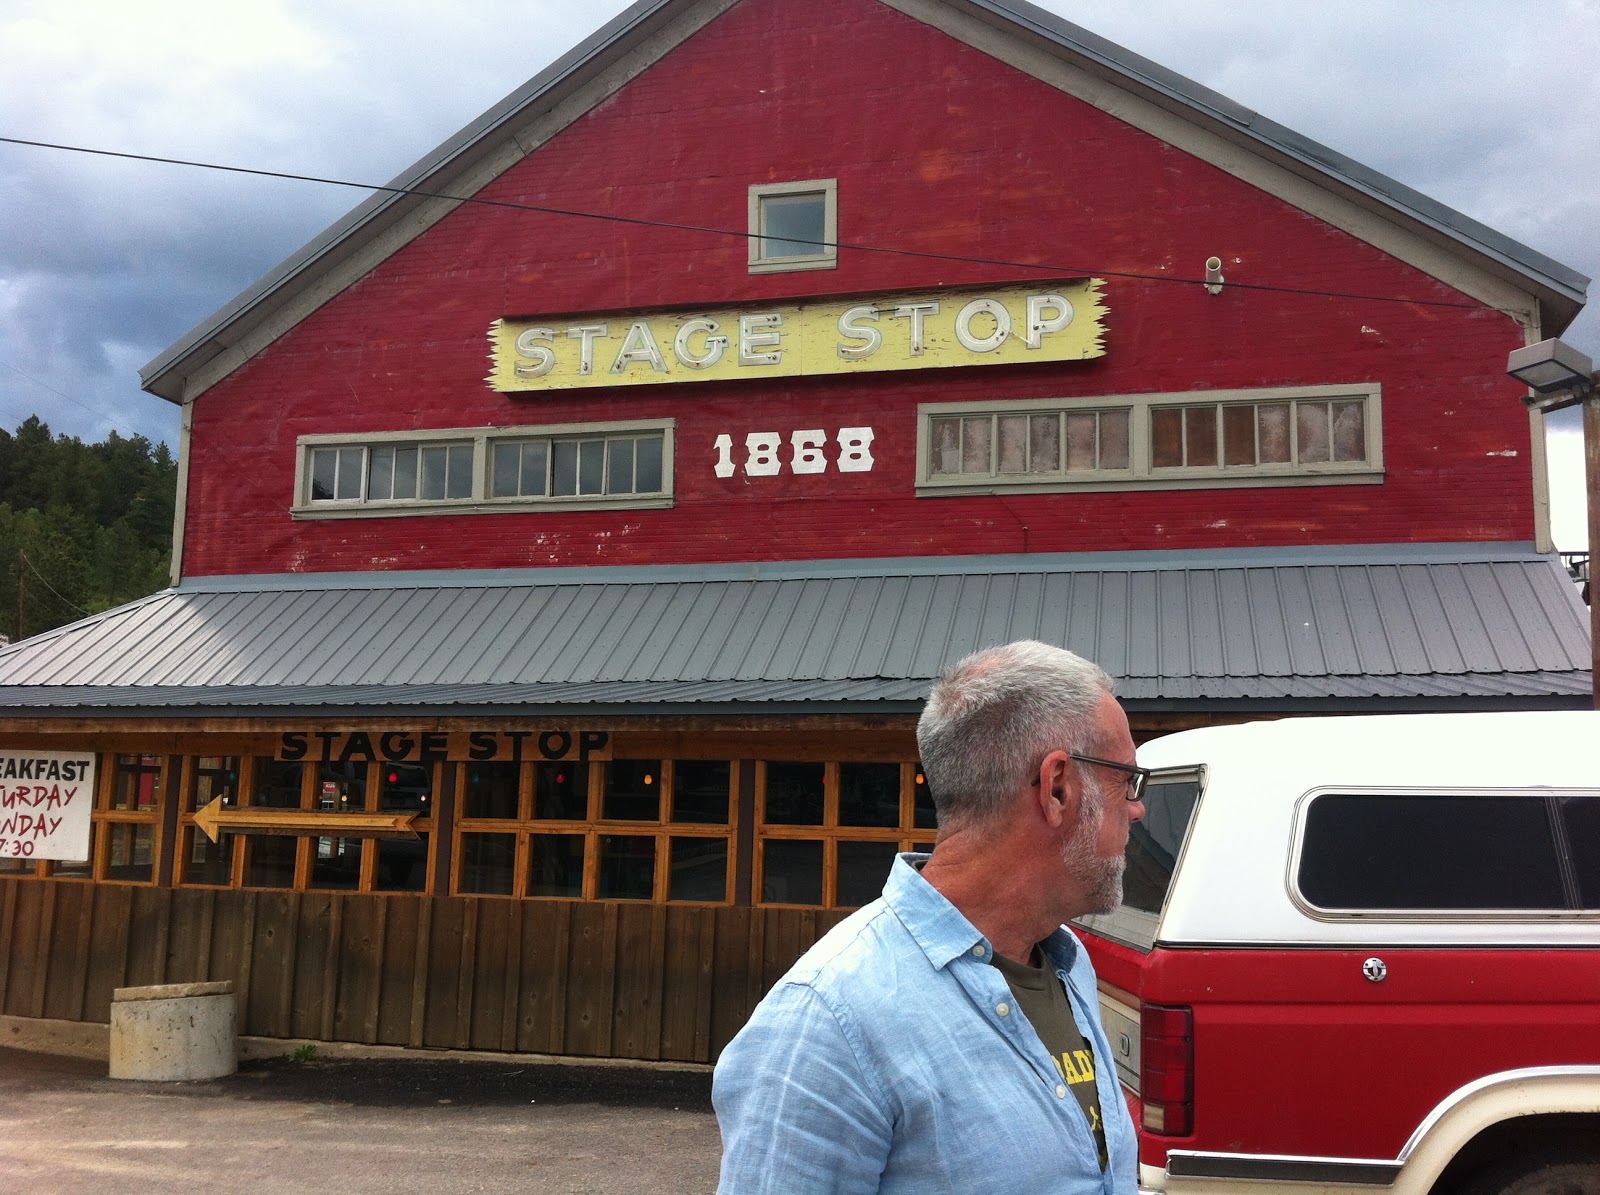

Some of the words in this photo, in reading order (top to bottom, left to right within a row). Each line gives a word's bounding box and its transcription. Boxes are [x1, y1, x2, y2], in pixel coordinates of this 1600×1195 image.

[514, 312, 783, 379] STAGE
[837, 294, 1075, 361] STOP
[713, 426, 875, 478] 1868
[281, 731, 449, 762] STAGE
[469, 731, 609, 763] STOP
